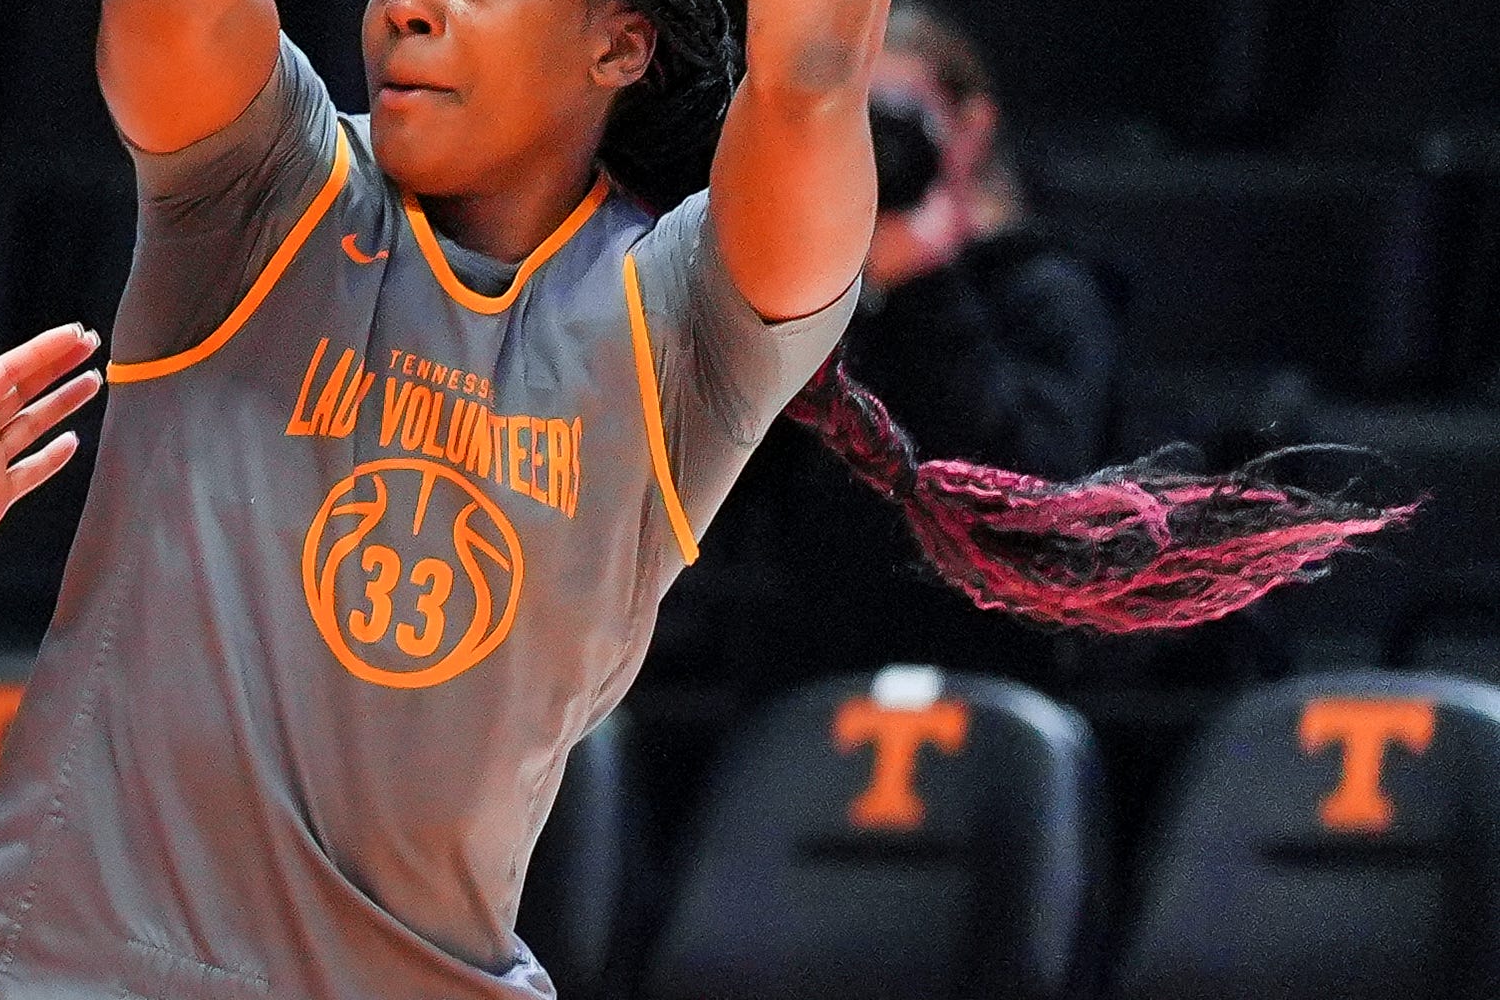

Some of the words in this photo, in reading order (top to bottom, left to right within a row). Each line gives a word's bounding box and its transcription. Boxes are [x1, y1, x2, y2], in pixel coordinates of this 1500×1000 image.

[389, 349, 496, 400] TENNESS
[379, 377, 582, 520] VOLUNTEERS
[349, 545, 454, 657] 33
[833, 698, 969, 829] T
[1299, 698, 1434, 832] T
